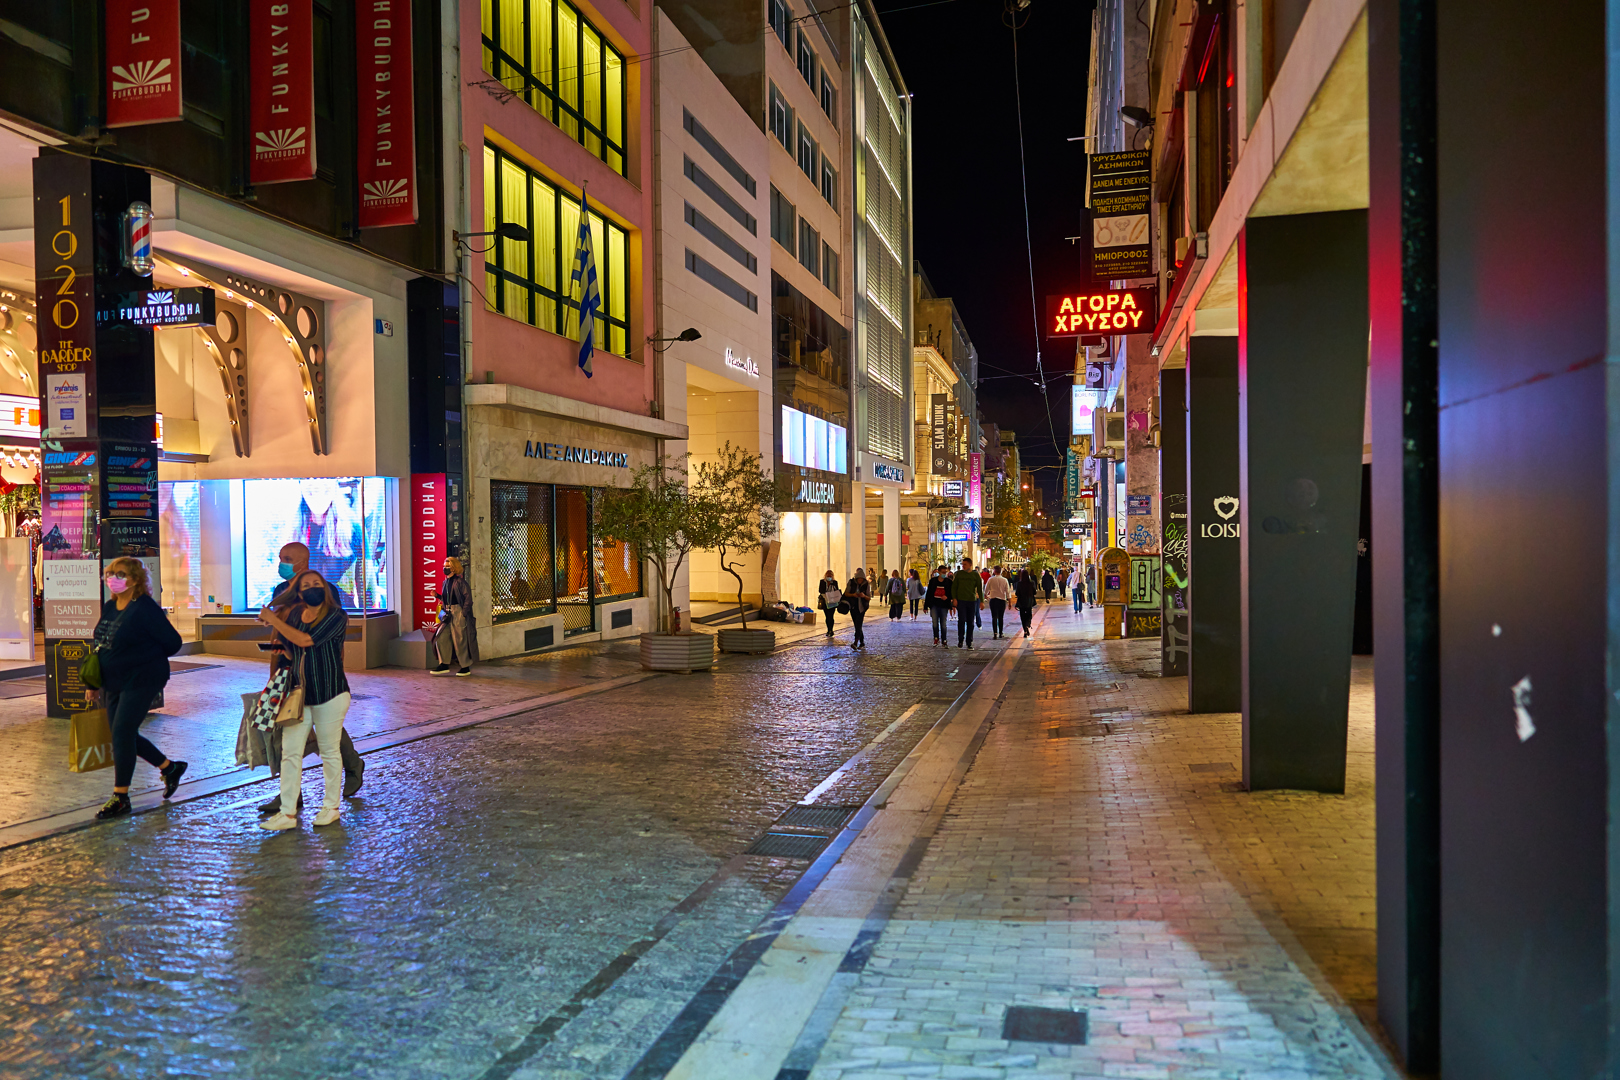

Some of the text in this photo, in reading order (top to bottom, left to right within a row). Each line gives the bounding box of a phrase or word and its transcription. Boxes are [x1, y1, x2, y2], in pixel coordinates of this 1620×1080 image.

[131, 8, 150, 44] FU
[112, 84, 172, 100] FUNKYBUDDHA
[255, 148, 306, 161] FUNKYBUDDHA
[1093, 151, 1149, 162] ΧΡΥΣΑΦΙΚΩΝ
[1098, 160, 1144, 170] ΑΣΗΜΙΚΩΝ
[1093, 179, 1114, 188] ΔΑΝΕΙΑ
[1115, 178, 1123, 186] ΜΕ
[1095, 250, 1148, 261] ΗΜΙΟΡΟΦΟΣ
[1059, 293, 1137, 313] ΑΓΟΡΑ
[120, 303, 200, 320] FUNKYBUDDHA
[1054, 310, 1143, 332] ΧΡΥΣΟΥ
[59, 341, 73, 349] THE
[41, 347, 92, 364] BARBER
[56, 363, 77, 372] SHOP
[934, 404, 945, 449] SLAM DUNK
[44, 452, 79, 464] GINIS
[524, 440, 629, 468] ΑΛΕΞΑΝΔΡΑΚΗΣ
[801, 480, 835, 504] PULL&BEAR
[422, 481, 436, 615] FUNKYBUDDHA
[49, 565, 94, 574] ΤΣΑΝΤΙΛΗΣ
[53, 605, 92, 615] TSANTILIS
